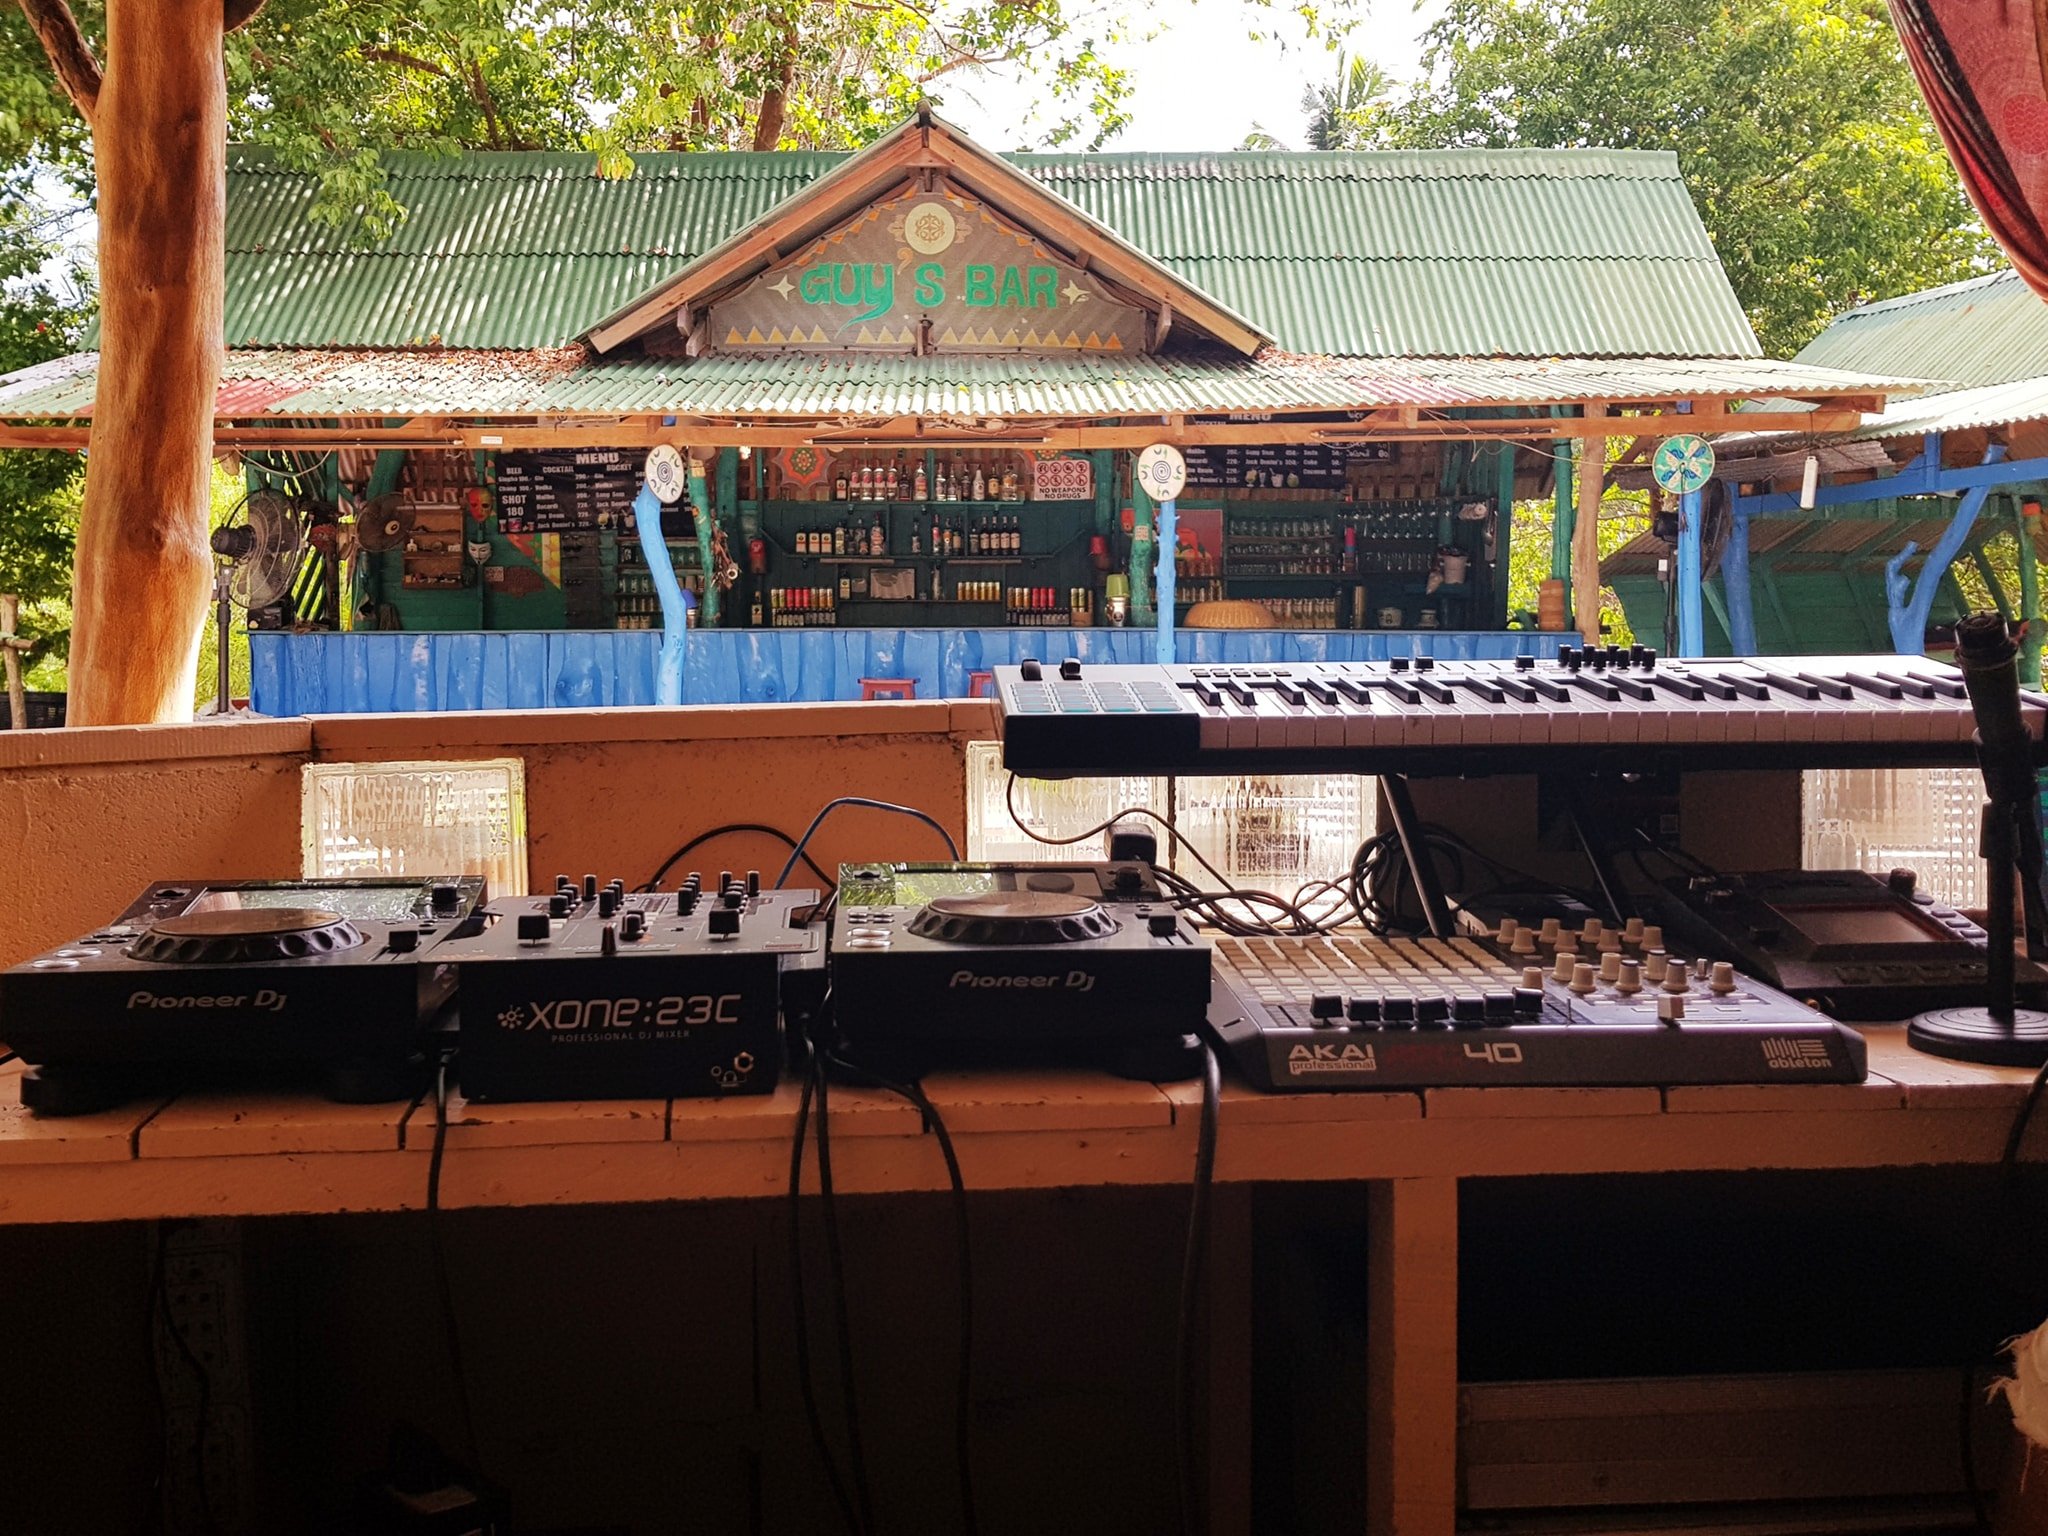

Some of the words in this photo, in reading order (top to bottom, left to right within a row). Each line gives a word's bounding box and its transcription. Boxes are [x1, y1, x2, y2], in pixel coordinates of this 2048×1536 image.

[965, 263, 1058, 308] BAR
[576, 452, 619, 464] MENU
[502, 494, 527, 504] SHOT
[506, 506, 524, 517] 180
[949, 970, 1060, 989] Pioneer
[126, 990, 248, 1009] Pioneer
[551, 1031, 634, 1043] PROFESSIONAL
[639, 1031, 651, 1041] DJ
[656, 1030, 690, 1039] MIXER
[1288, 1043, 1375, 1060] AKAI
[1463, 1042, 1524, 1063] 40
[1290, 1060, 1377, 1075] professional
[1768, 1056, 1832, 1069] ableton
